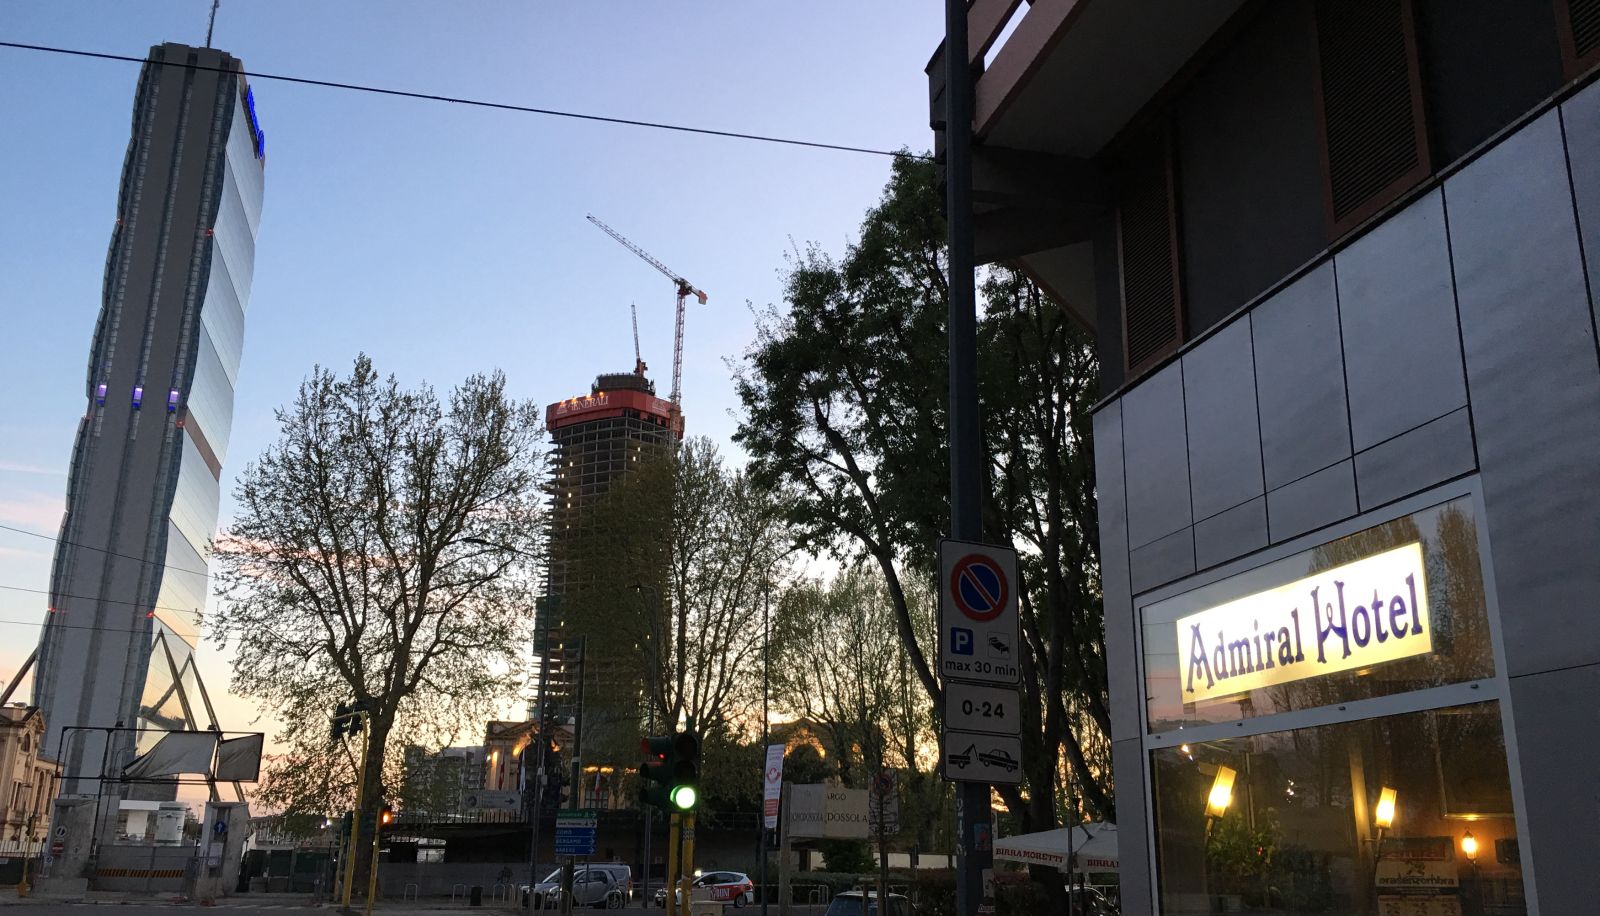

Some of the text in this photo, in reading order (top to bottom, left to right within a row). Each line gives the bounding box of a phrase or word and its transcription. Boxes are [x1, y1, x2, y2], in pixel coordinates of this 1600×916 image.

[1186, 573, 1423, 692] Admiral Hotel
[955, 632, 969, 651] P
[946, 661, 1017, 677] max 30 min
[962, 700, 1004, 718] 0-24
[996, 848, 1064, 863] BIRRA MORETTI
[1088, 859, 1115, 868] BIRRA
